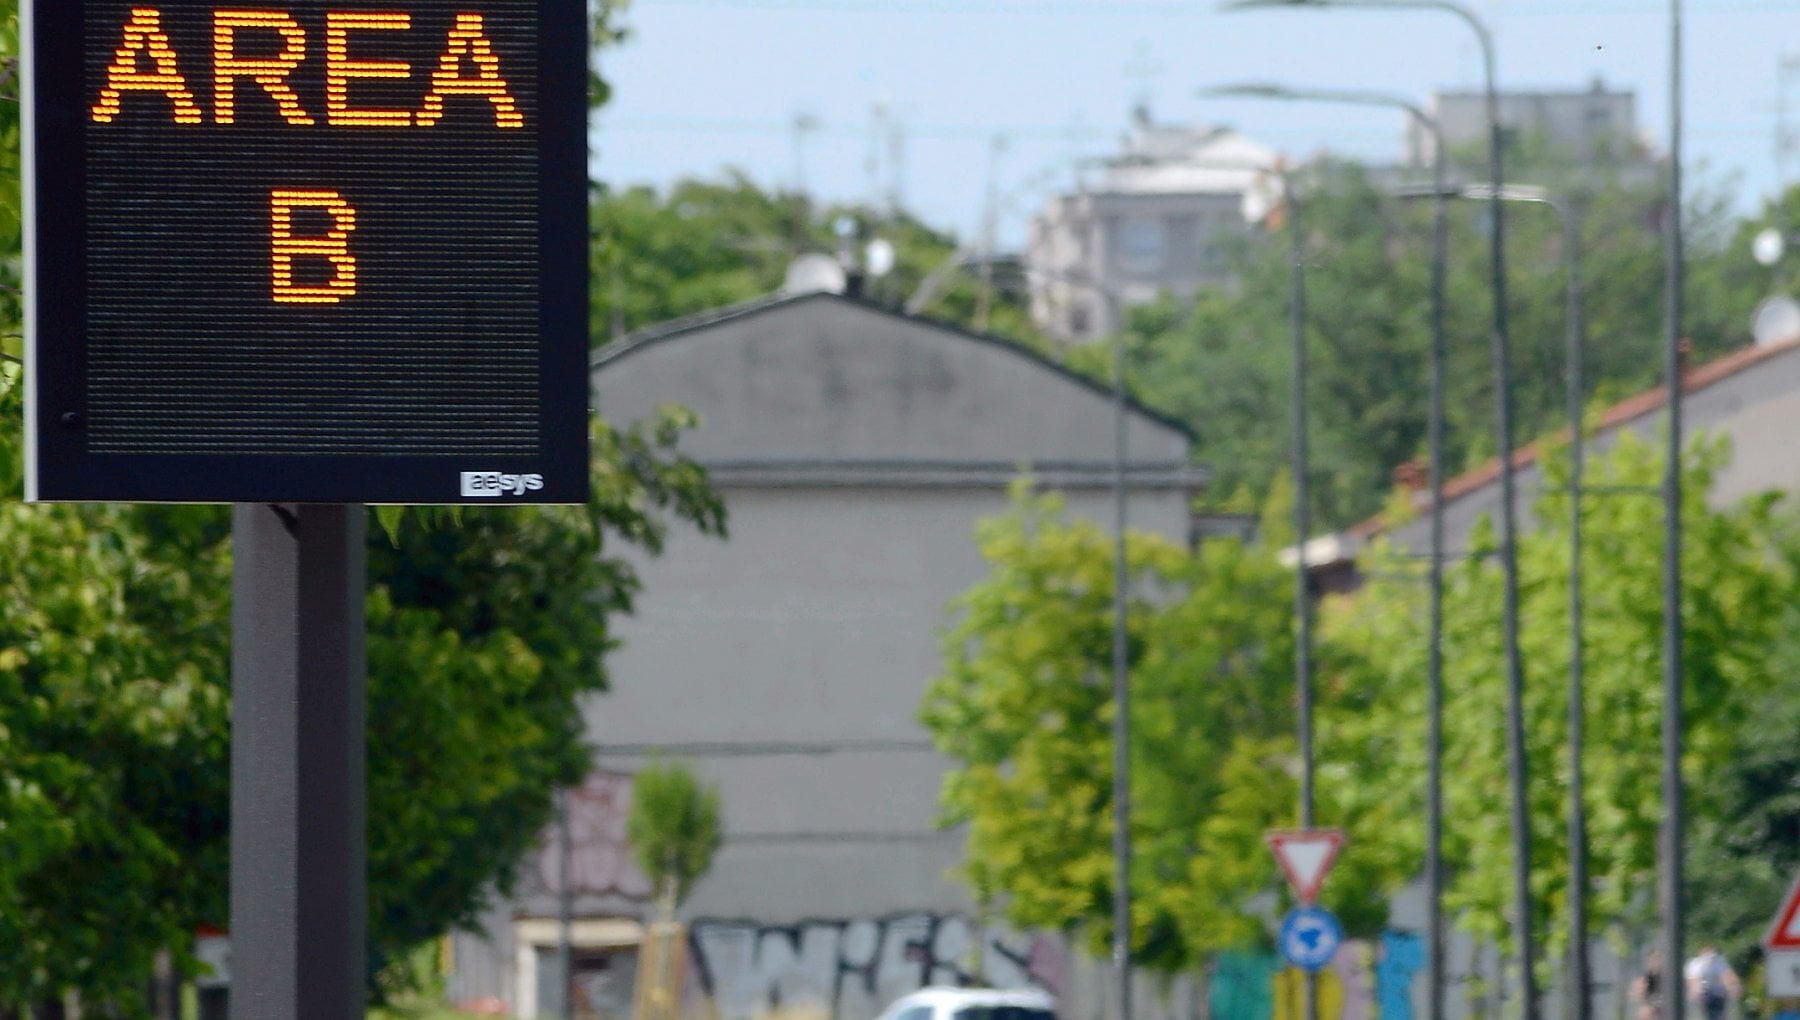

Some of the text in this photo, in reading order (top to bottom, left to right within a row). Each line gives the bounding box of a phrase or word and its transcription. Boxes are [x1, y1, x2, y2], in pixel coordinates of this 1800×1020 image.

[91, 8, 524, 128] AREA
[271, 190, 356, 303] B
[471, 473, 544, 496] aesys
